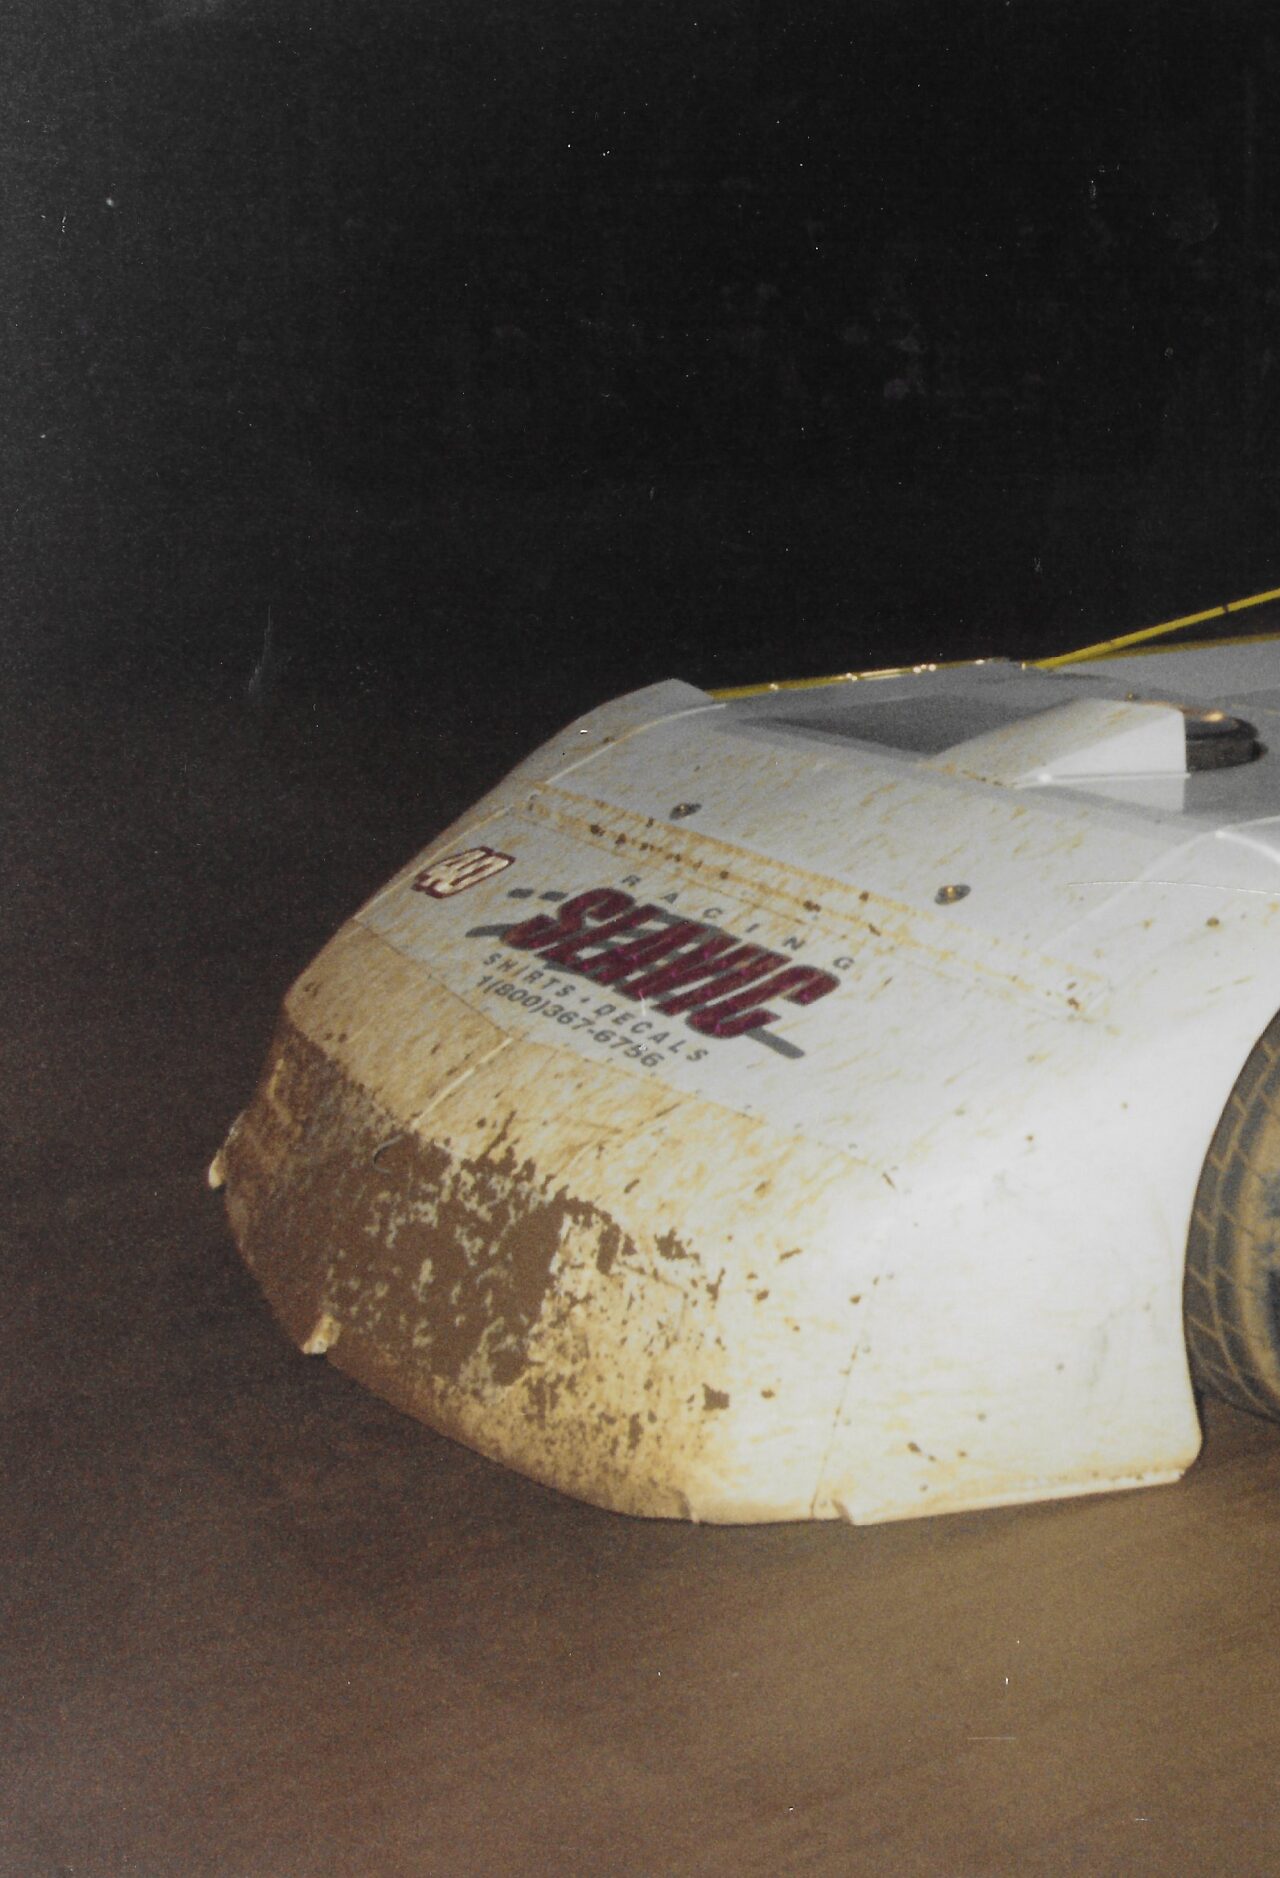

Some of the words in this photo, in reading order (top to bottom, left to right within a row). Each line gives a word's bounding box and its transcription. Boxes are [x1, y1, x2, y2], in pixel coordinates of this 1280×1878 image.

[412, 847, 515, 898] 40
[621, 874, 856, 971] RACING
[483, 953, 577, 998] SHIRTS
[594, 1003, 709, 1062] DECALS
